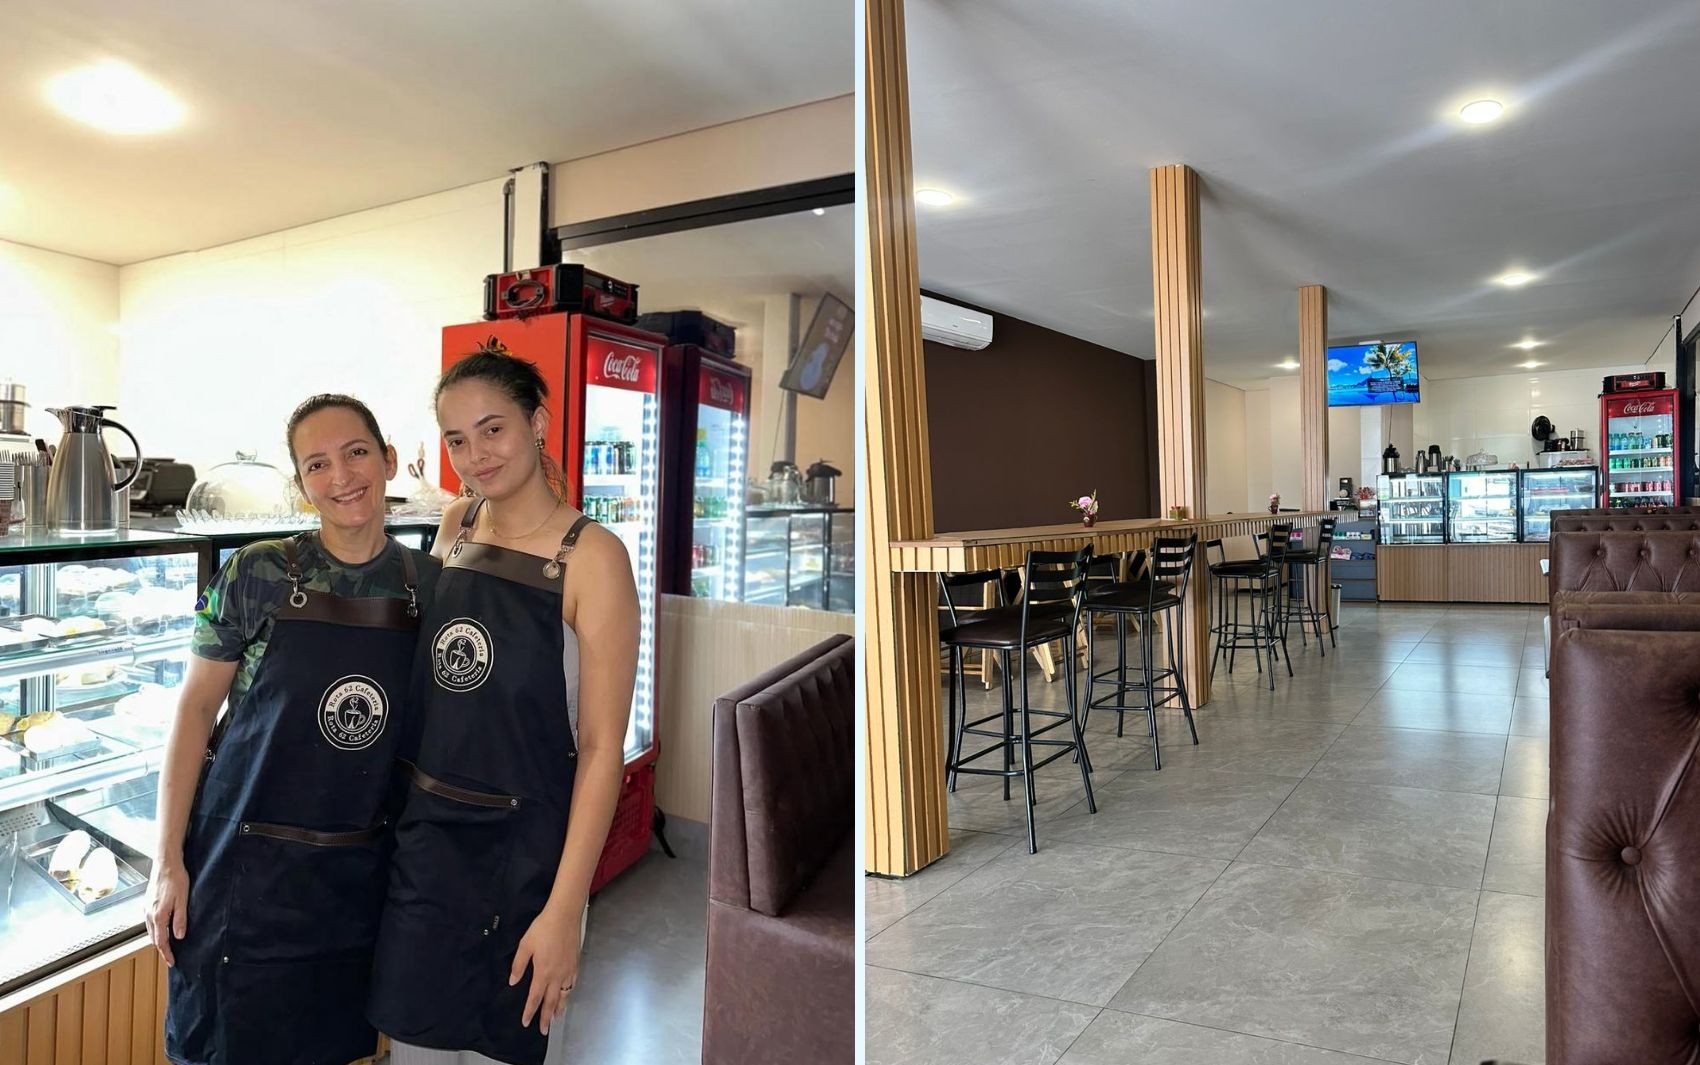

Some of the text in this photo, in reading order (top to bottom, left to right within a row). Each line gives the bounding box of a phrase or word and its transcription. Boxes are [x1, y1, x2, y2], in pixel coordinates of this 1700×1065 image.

[328, 684, 379, 711] Rota 62 Cafeteria
[327, 715, 379, 742] Rota 62 Cafeteria
